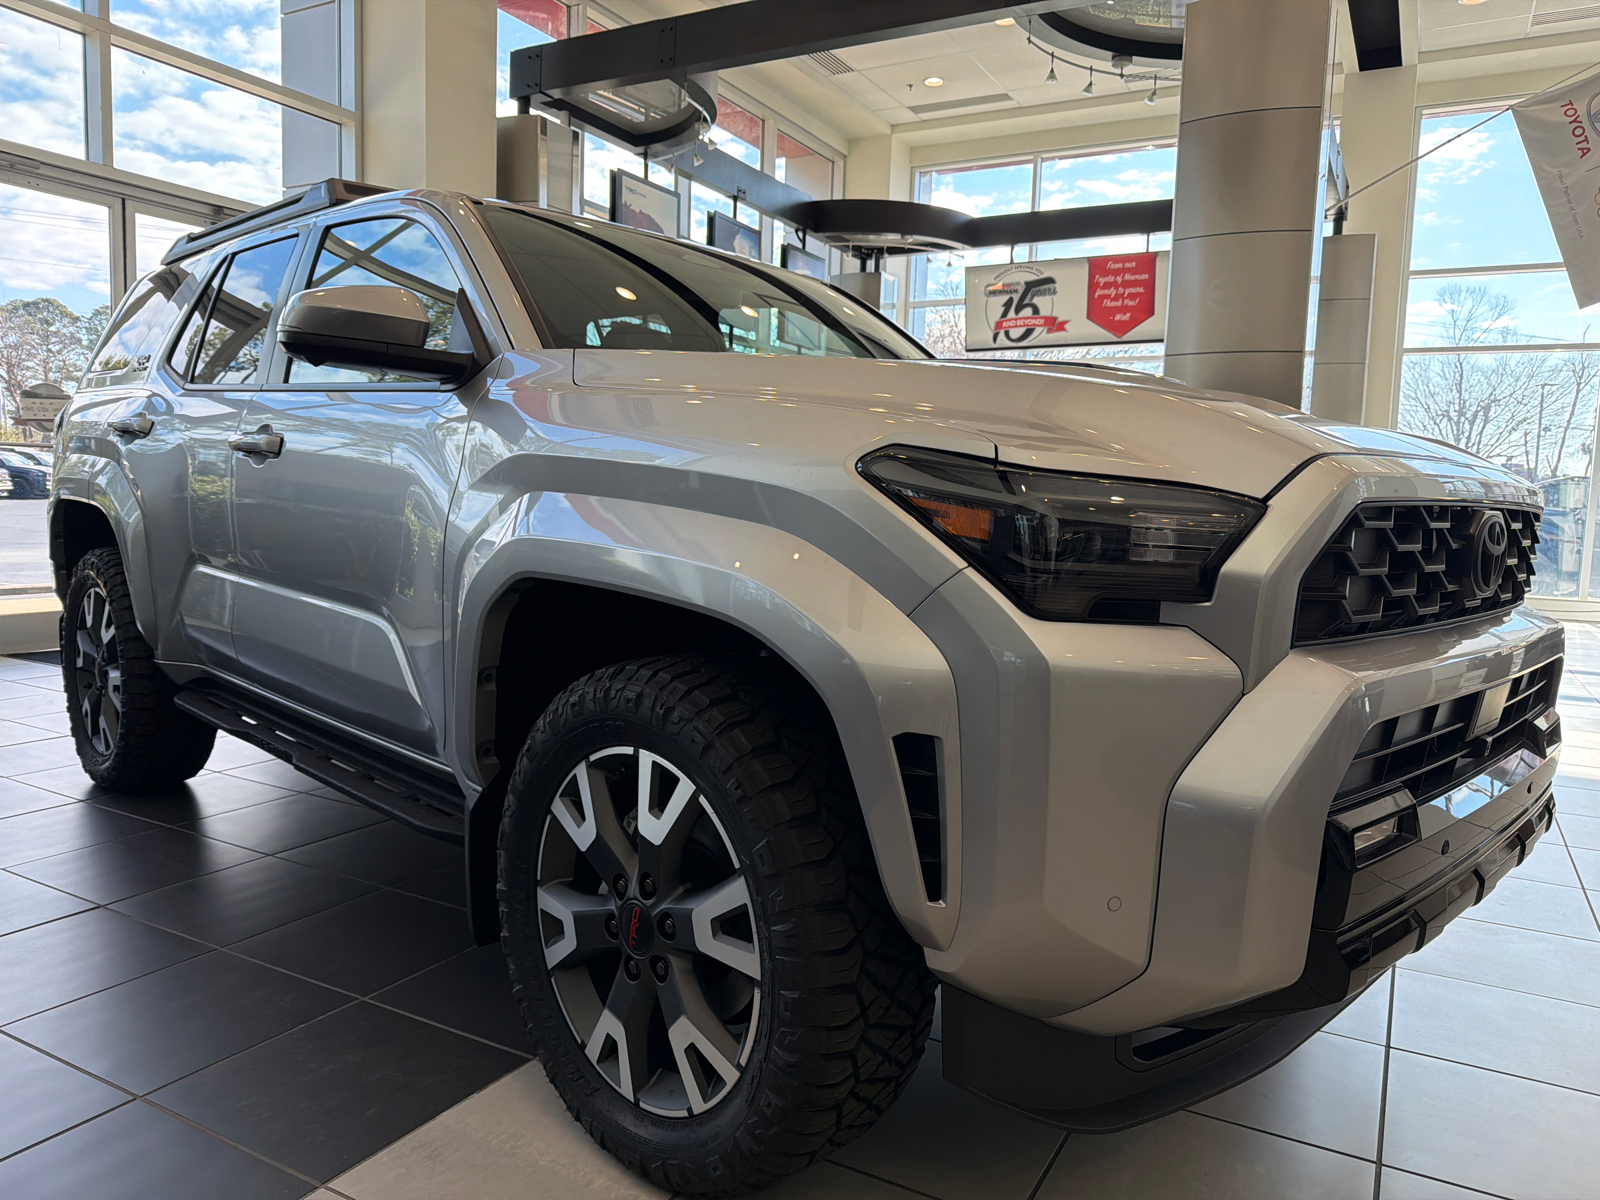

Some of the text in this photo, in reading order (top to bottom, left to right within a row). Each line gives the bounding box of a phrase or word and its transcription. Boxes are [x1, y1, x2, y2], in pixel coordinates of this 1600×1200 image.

[1560, 99, 1592, 160] TOYOTA
[1557, 169, 1567, 186] Proud
[1563, 185, 1573, 205] Partner
[1572, 211, 1580, 227] Team
[1576, 226, 1585, 240] USA
[1106, 261, 1123, 270] From
[1093, 274, 1115, 287] Toyota
[1115, 273, 1123, 285] of
[988, 288, 1019, 296] NEWNAN
[1094, 286, 1117, 299] family
[1117, 286, 1124, 295] to
[1102, 298, 1140, 308] Thank You!
[993, 276, 1058, 344] 15 years
[1002, 318, 1045, 328] AND BEYOND!
[629, 907, 640, 948] TRD
